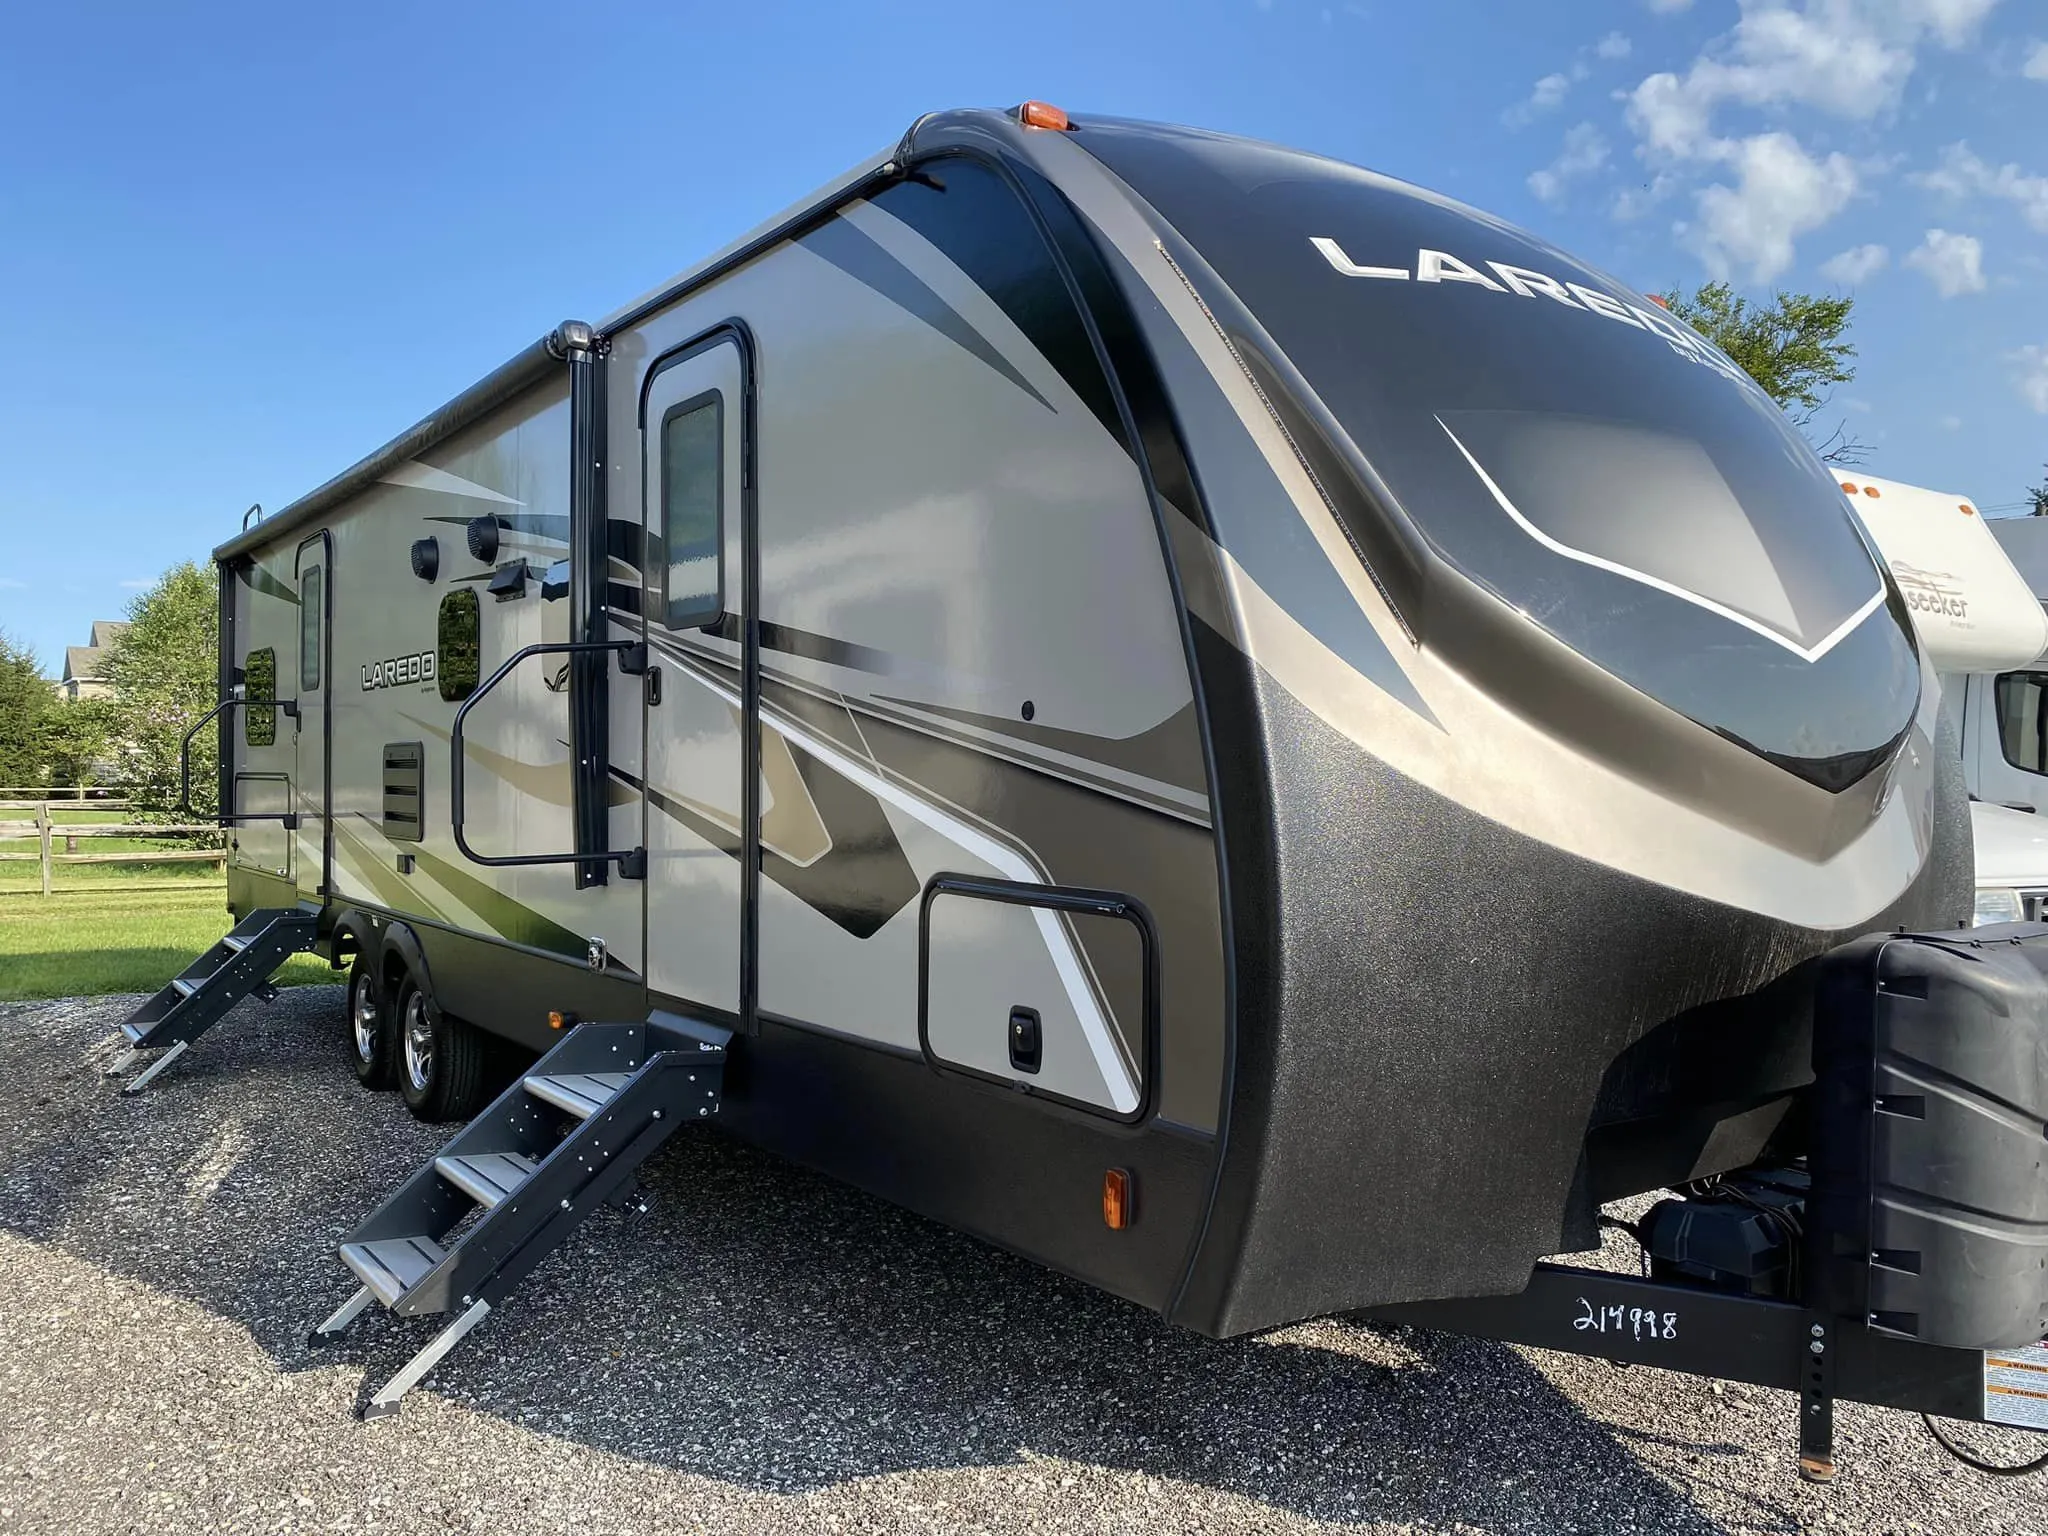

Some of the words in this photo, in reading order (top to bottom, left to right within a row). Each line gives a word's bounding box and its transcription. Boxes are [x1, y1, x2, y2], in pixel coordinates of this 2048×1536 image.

[1309, 237, 1746, 382] LAREDO
[361, 650, 436, 692] LAREDO
[2013, 1361, 2047, 1372] WARNING
[2013, 1389, 2048, 1399] WARNING
